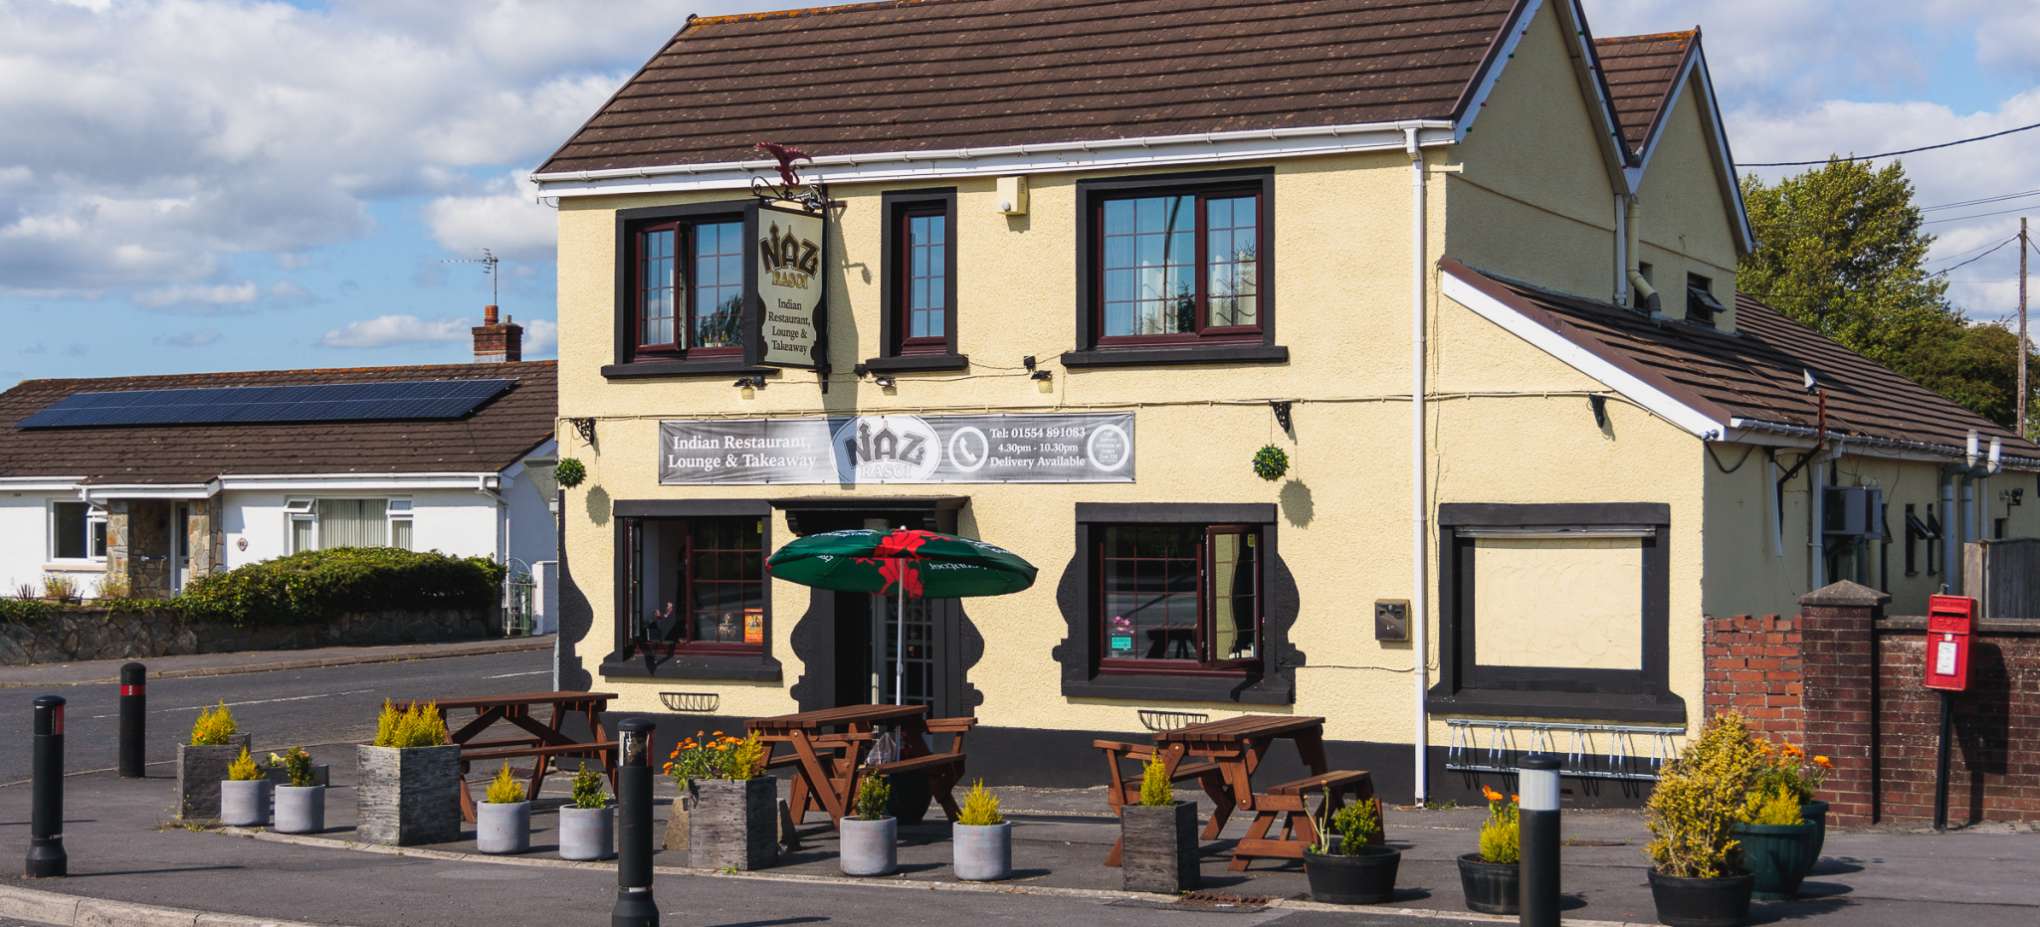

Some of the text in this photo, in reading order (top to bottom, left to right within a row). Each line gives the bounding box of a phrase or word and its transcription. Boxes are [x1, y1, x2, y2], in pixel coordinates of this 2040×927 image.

[778, 298, 802, 310] Indian
[768, 312, 810, 326] Restaurant,
[772, 325, 808, 341] Lounge &
[771, 340, 808, 355] Takeaway
[990, 428, 1009, 439] Tel:
[1011, 427, 1043, 438] 01554
[673, 434, 811, 450] Indian Restaurant,
[998, 443, 1032, 454] 4.30pm
[1039, 443, 1079, 454] 10.30pm
[668, 453, 817, 472] Lounge & Takeaway
[990, 455, 1086, 469] Delivery Available
